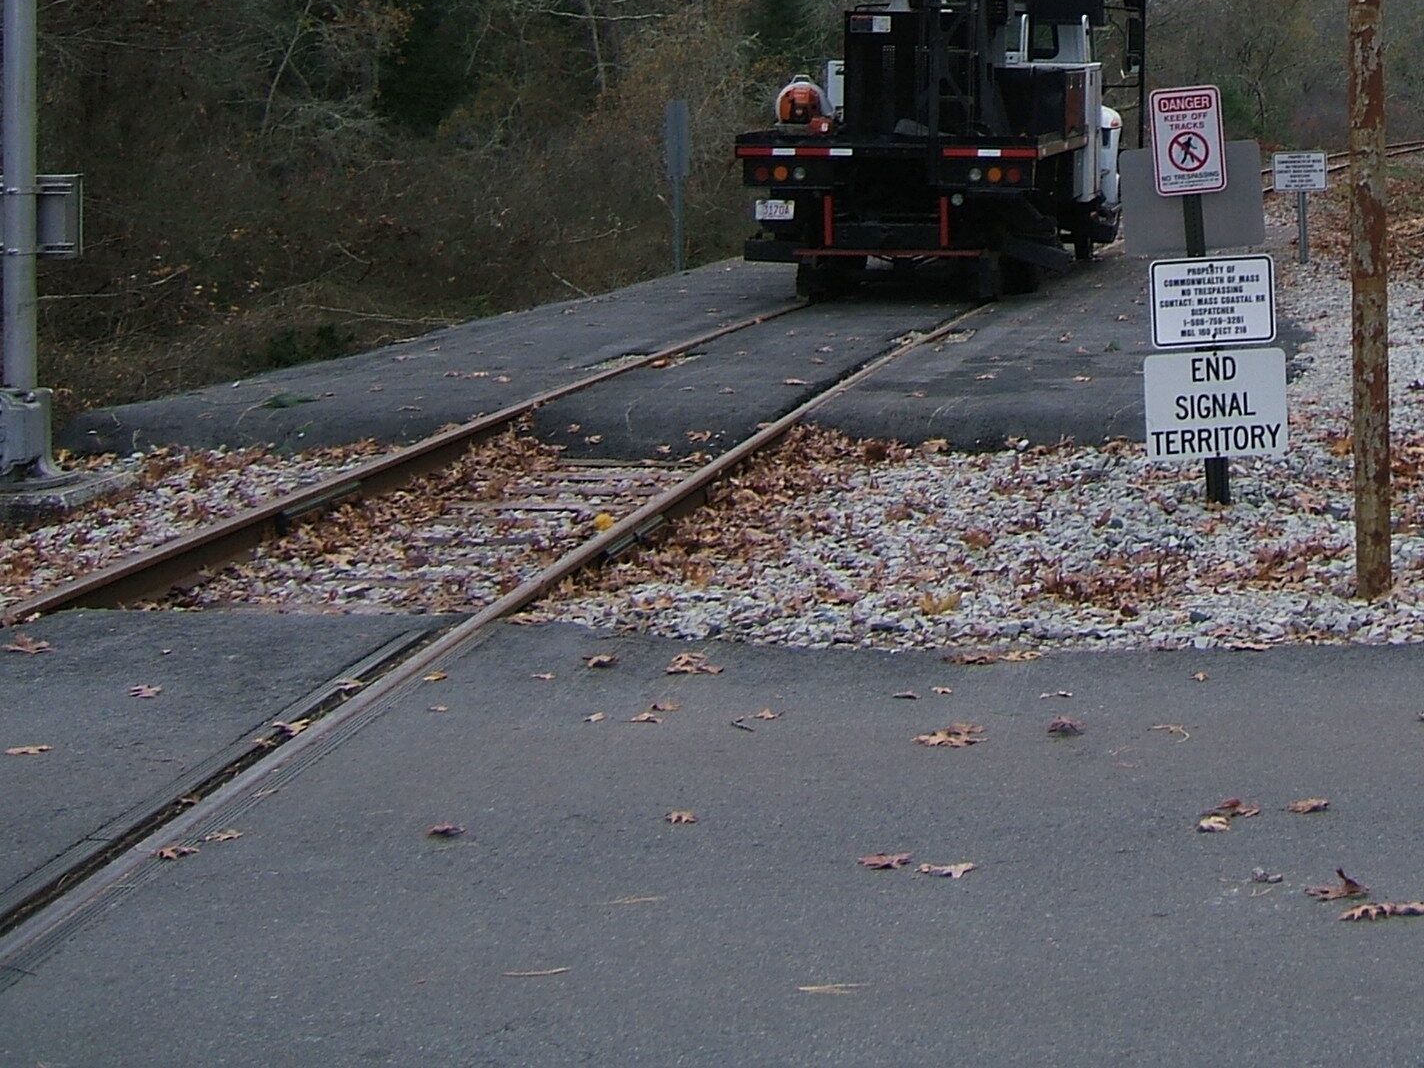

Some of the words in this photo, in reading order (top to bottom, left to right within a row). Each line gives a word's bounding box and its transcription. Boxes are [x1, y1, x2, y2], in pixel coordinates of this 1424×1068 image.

[1160, 96, 1210, 112] DANGER
[1163, 113, 1187, 122] KEEP
[1191, 111, 1208, 120] OFF
[1169, 121, 1205, 131] TRACKS
[1174, 170, 1220, 180] TRESPASSING
[1187, 266, 1224, 275] PROPERTY
[1226, 265, 1236, 273] OF
[1163, 277, 1225, 287] COMMONWEALTH
[1227, 275, 1237, 283] OF
[1239, 274, 1260, 283] MASS
[1181, 288, 1192, 297] NO
[1194, 285, 1244, 296] TRESPASSING
[1160, 298, 1195, 308] CONTACT:
[1197, 296, 1219, 306] MASS
[1221, 295, 1254, 304] COASTAL
[1256, 294, 1266, 302] RR
[1191, 306, 1236, 316] DISPATCHER
[1181, 329, 1196, 337] MGL
[1214, 326, 1233, 335] SECT
[1191, 356, 1237, 383] END
[1175, 391, 1257, 420] SIGNAL
[1151, 423, 1281, 456] TERRITORY
